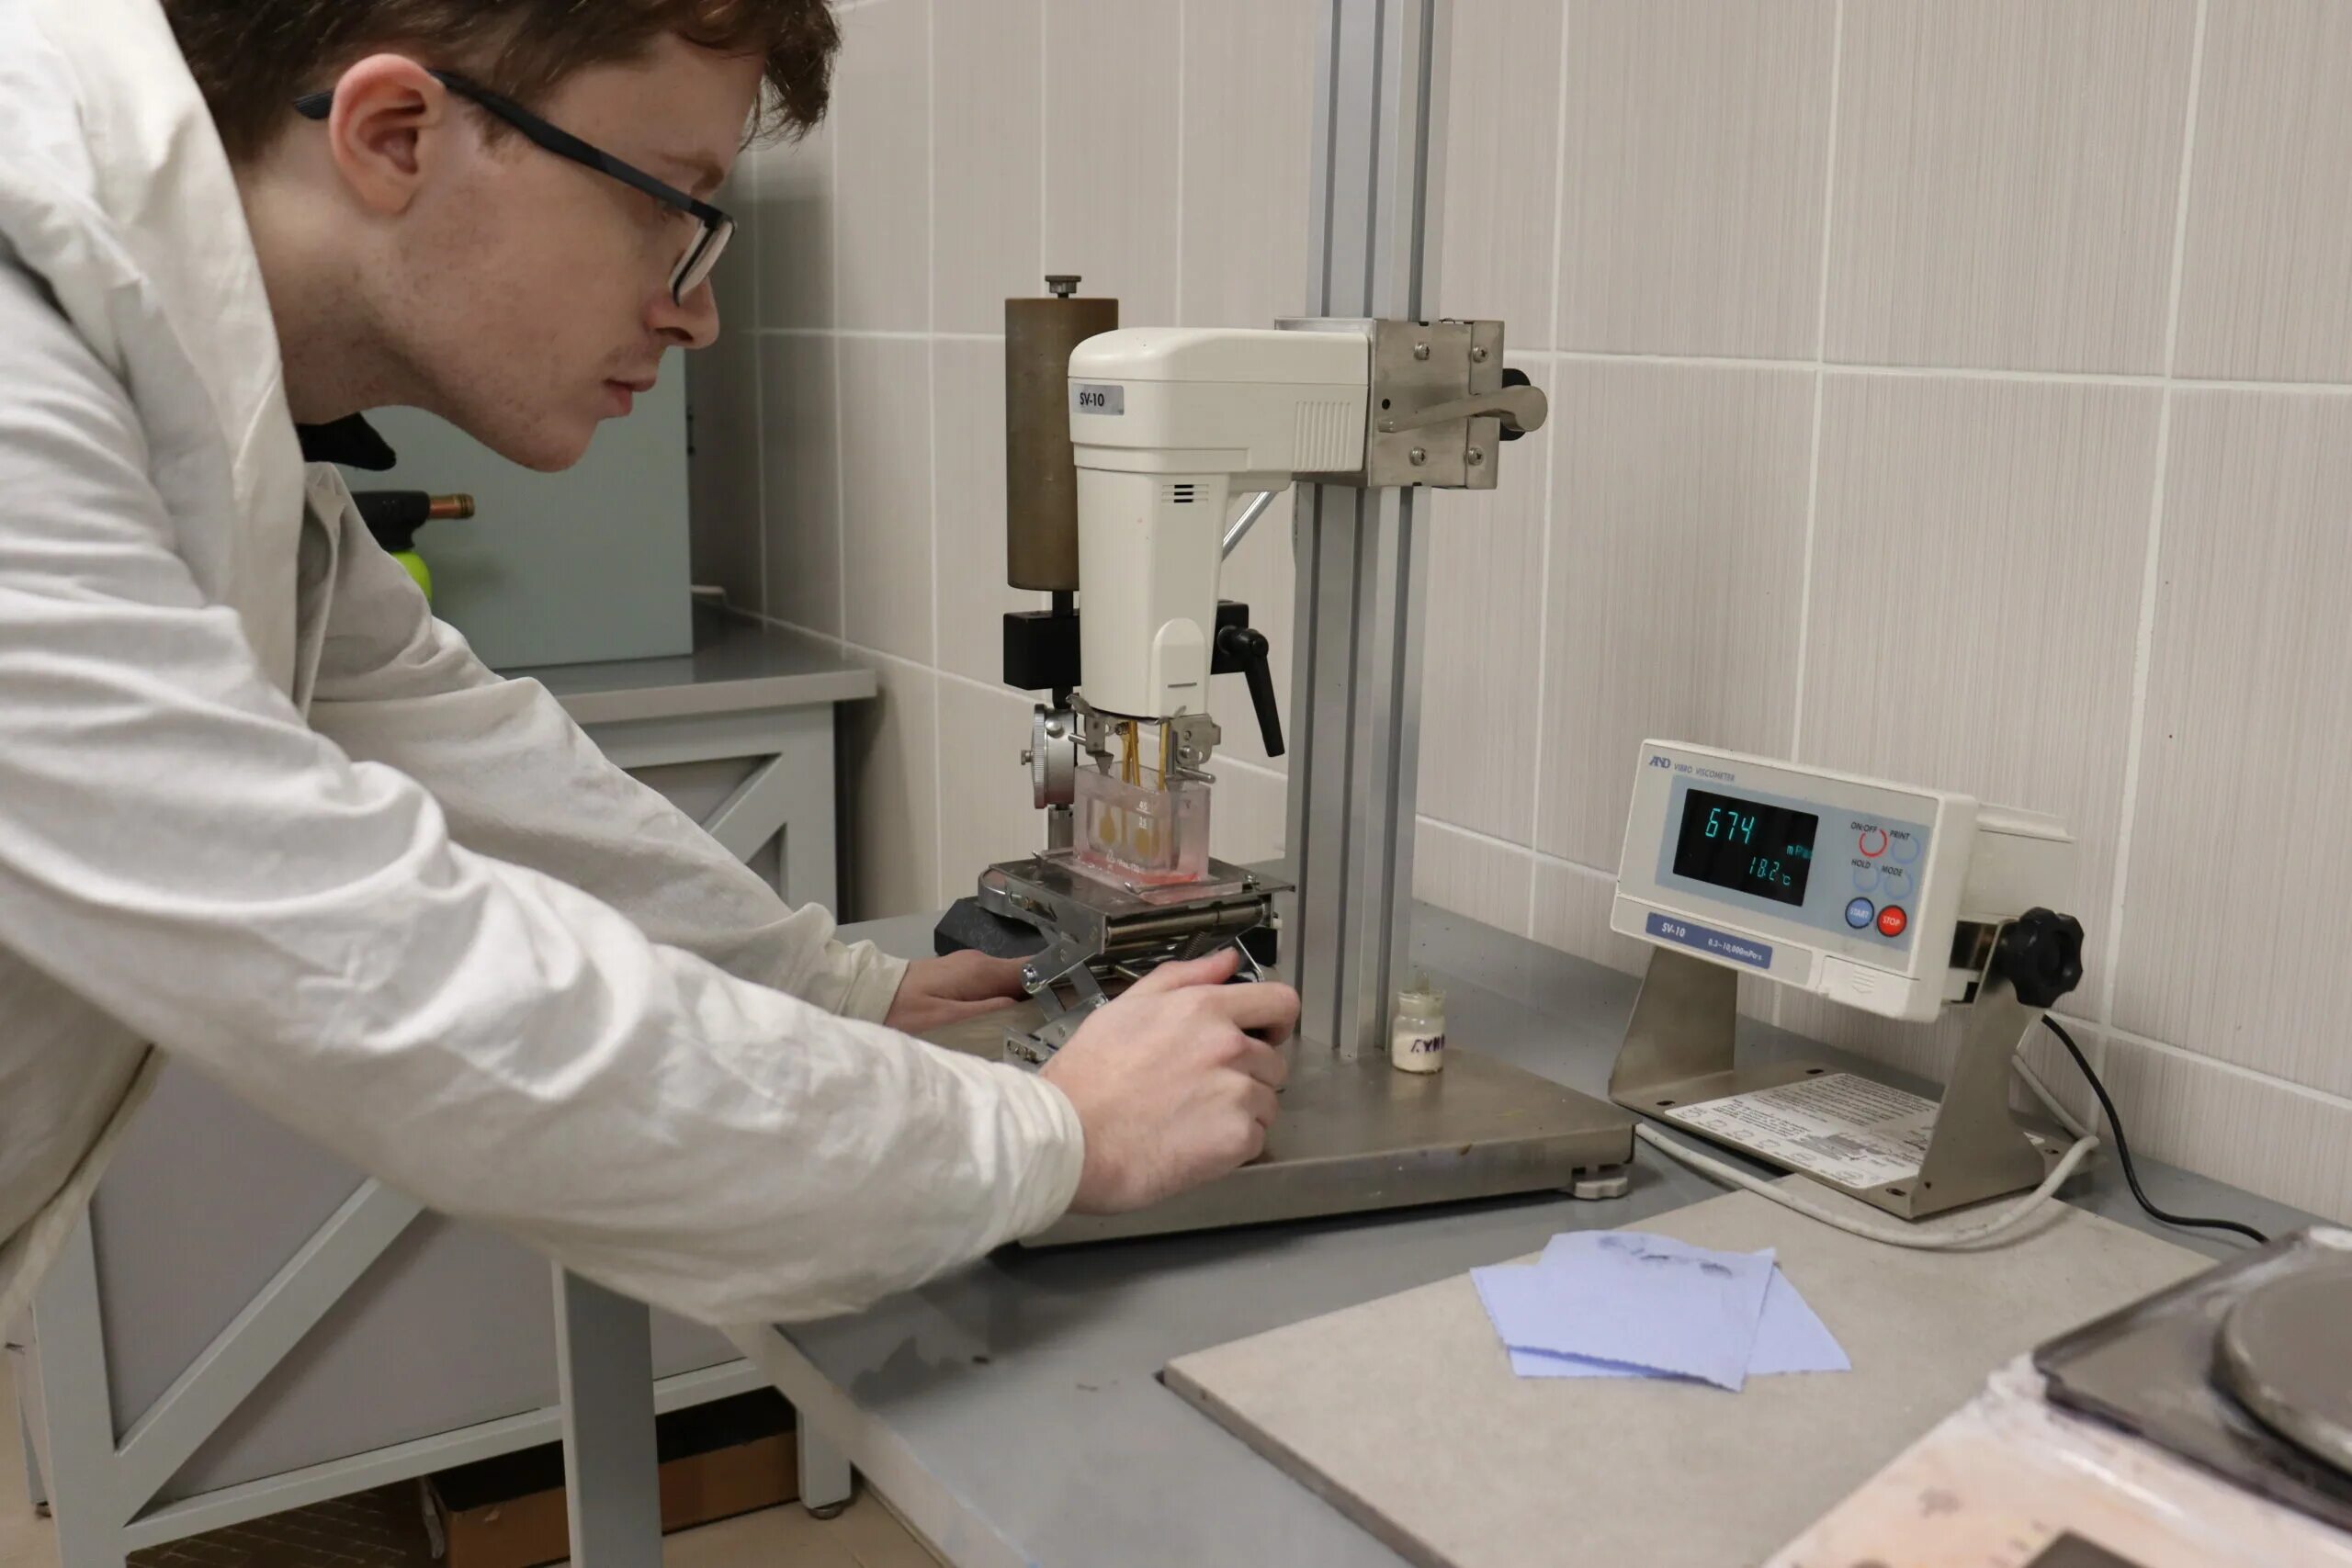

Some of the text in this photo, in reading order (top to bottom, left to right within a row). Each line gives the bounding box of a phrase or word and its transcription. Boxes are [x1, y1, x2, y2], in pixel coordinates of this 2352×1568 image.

[1080, 392, 1104, 407] SV-10
[1696, 768, 1736, 782] VISCOMETER
[1705, 807, 1755, 845] 674
[1890, 829, 1911, 840] PRINT
[1851, 859, 1871, 869] HOLD
[1881, 865, 1904, 876] MODE
[1849, 907, 1870, 919] START
[1883, 916, 1901, 927] STOP
[1661, 922, 1686, 938] SV-10
